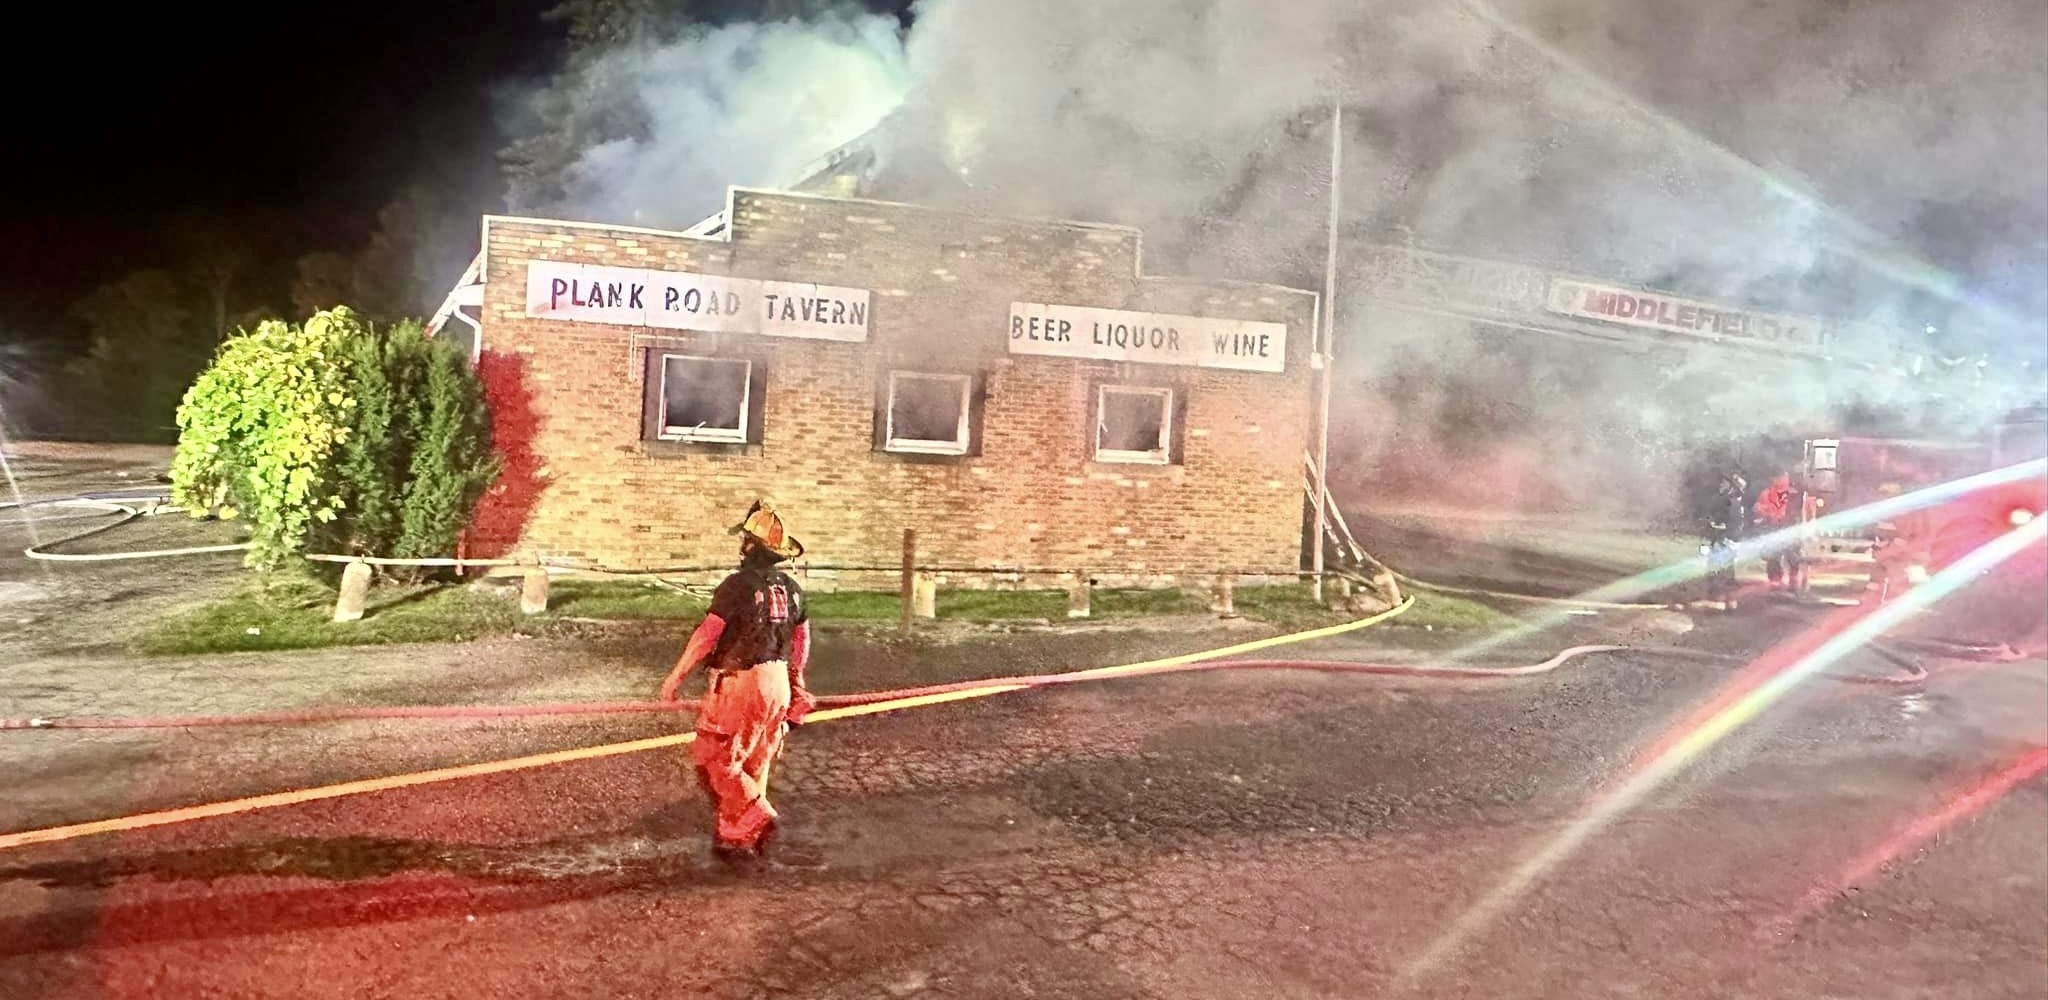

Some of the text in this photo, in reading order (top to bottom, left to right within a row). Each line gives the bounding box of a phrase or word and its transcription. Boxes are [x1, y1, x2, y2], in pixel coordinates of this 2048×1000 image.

[550, 278, 866, 326] PLANK ROAD TAVERN
[1011, 315, 1270, 358] BEER LIQUOR WINE
